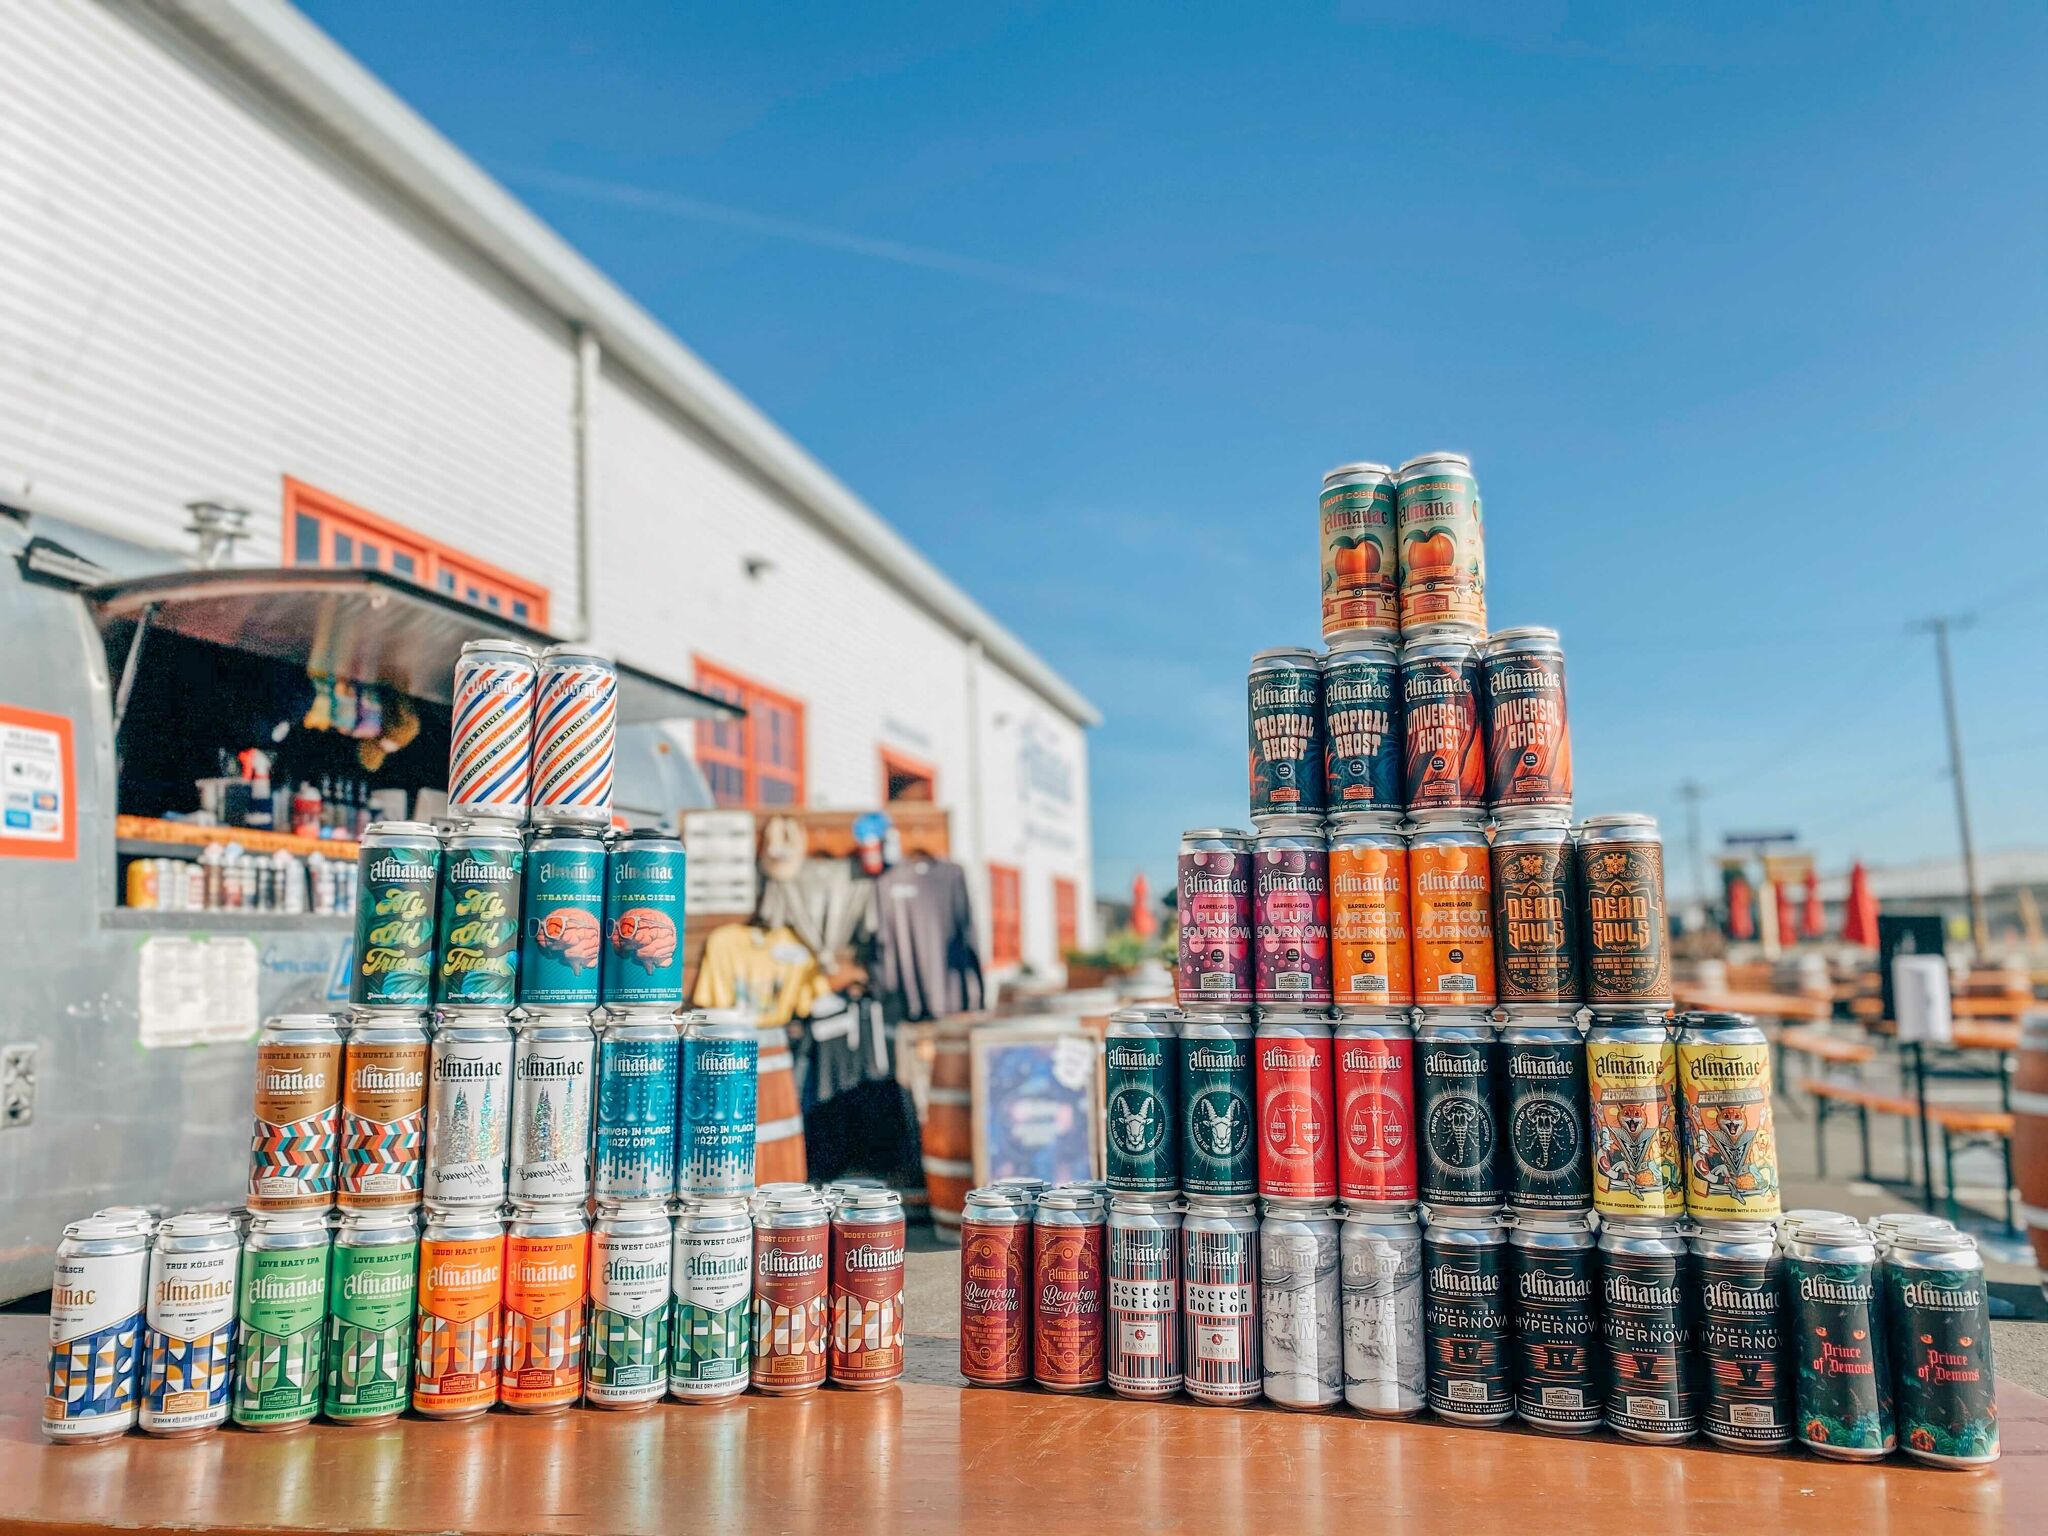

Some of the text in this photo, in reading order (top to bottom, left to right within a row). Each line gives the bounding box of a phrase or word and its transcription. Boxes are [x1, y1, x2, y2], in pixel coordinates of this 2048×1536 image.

[1326, 678, 1390, 707] Almanac
[1404, 672, 1471, 702] Almanac
[1490, 666, 1560, 696] Almanac
[1252, 683, 1316, 711] Almanac
[1254, 713, 1314, 740] TROPICAL
[1328, 709, 1389, 737] TROPICAL
[1407, 704, 1471, 735] UNIVERSAL
[1494, 698, 1560, 731] UNIVERSAL
[1335, 733, 1381, 759] GHOST
[1418, 728, 1460, 754] GHOST
[1508, 722, 1552, 749] GHOST
[1262, 736, 1308, 762] GHOST
[370, 857, 435, 881] Almanac
[451, 858, 514, 882] Almanac
[1417, 867, 1486, 896] Almanac
[1184, 871, 1248, 898] Almanac
[1258, 869, 1323, 897] Almanac
[1334, 869, 1400, 897] Almanac
[376, 888, 427, 921] My
[456, 888, 506, 921] My
[1271, 911, 1313, 923] PLUM
[1420, 910, 1487, 923] APRICOT
[1508, 897, 1563, 919] DEAD
[1591, 896, 1647, 919] DEAD
[1196, 912, 1237, 924] PLUM
[1336, 911, 1400, 924] APRICOT
[370, 920, 420, 948] Old
[451, 921, 499, 948] Old
[1182, 926, 1251, 938] SOURNOVA
[1257, 925, 1328, 938] SOURNOVA
[1333, 927, 1406, 939] SOURNOVA
[1416, 926, 1492, 939] SOURNOVA
[1509, 920, 1565, 951] SOULS
[1592, 920, 1650, 950] SOULS
[434, 1054, 501, 1082] Almanac
[517, 1053, 584, 1080] Almanac
[605, 1052, 665, 1080] Almanac
[692, 1051, 750, 1075] Almanac
[1108, 1046, 1163, 1071] Almanac
[1188, 1047, 1247, 1071] Almanac
[1263, 1046, 1322, 1070] Almanac
[1342, 1048, 1402, 1072] Almanac
[1424, 1051, 1489, 1077] Almanac
[1508, 1053, 1574, 1078] Almanac
[1595, 1052, 1664, 1078] Almanac
[1690, 1053, 1760, 1081] Almanac
[256, 1065, 325, 1094] Almanac
[352, 1064, 423, 1093] Almanac
[600, 1080, 671, 1122] SIP
[685, 1079, 754, 1120] SIP
[644, 1126, 671, 1134] PLACE
[694, 1136, 743, 1145] HAZY DIPA
[720, 1124, 754, 1134] IN PLACE
[607, 1138, 656, 1147] HAZY DIPA
[432, 1166, 472, 1183] Bunny
[516, 1164, 555, 1182] Bunny
[598, 1242, 620, 1251] WAVES
[621, 1243, 643, 1251] WEST
[680, 1237, 745, 1246] WAVES WEST COAST
[778, 1234, 805, 1243] COFFEE
[867, 1230, 893, 1238] COFFEE
[353, 1256, 375, 1264] LOVE
[376, 1254, 400, 1263] HAZY
[432, 1245, 496, 1256] LOUD! HAZY DIPA
[556, 1243, 573, 1251] DIPA
[845, 1244, 904, 1272] Almanac
[165, 1259, 224, 1270] TRUE KÖLSCH
[258, 1257, 320, 1268] LOVE HAZY IPA
[509, 1258, 577, 1288] Almanac
[602, 1256, 668, 1285] Almanac
[686, 1251, 748, 1281] Almanac
[758, 1248, 824, 1276] Almanac
[968, 1263, 1006, 1278] Almanac
[1048, 1267, 1089, 1282] Almanac
[249, 1273, 325, 1305] Almanac
[344, 1269, 415, 1300] Almanac
[427, 1262, 499, 1291] Almanac
[1429, 1264, 1500, 1292] Almanac
[1519, 1269, 1591, 1298] Almanac
[1604, 1274, 1681, 1303] Almanac
[1800, 1274, 1874, 1302] Almanac
[155, 1276, 232, 1305] Almanac
[965, 1281, 1016, 1303] Bourbon
[1042, 1285, 1097, 1307] Bourbon
[1113, 1283, 1170, 1296] Secret
[1190, 1286, 1247, 1301] Secret
[1702, 1280, 1780, 1310] Almanac
[1903, 1281, 1980, 1308] Almanac
[1427, 1310, 1508, 1329] HYPERNOVA
[1434, 1306, 1467, 1315] BARREL
[1526, 1312, 1561, 1321] BARREL
[1610, 1318, 1645, 1328] BARREL
[1710, 1325, 1749, 1335] BARREL
[1822, 1342, 1861, 1359] Prince
[1927, 1349, 1968, 1366] Prince
[1813, 1358, 1874, 1377] of Demons
[1918, 1365, 1980, 1385] of Demons
